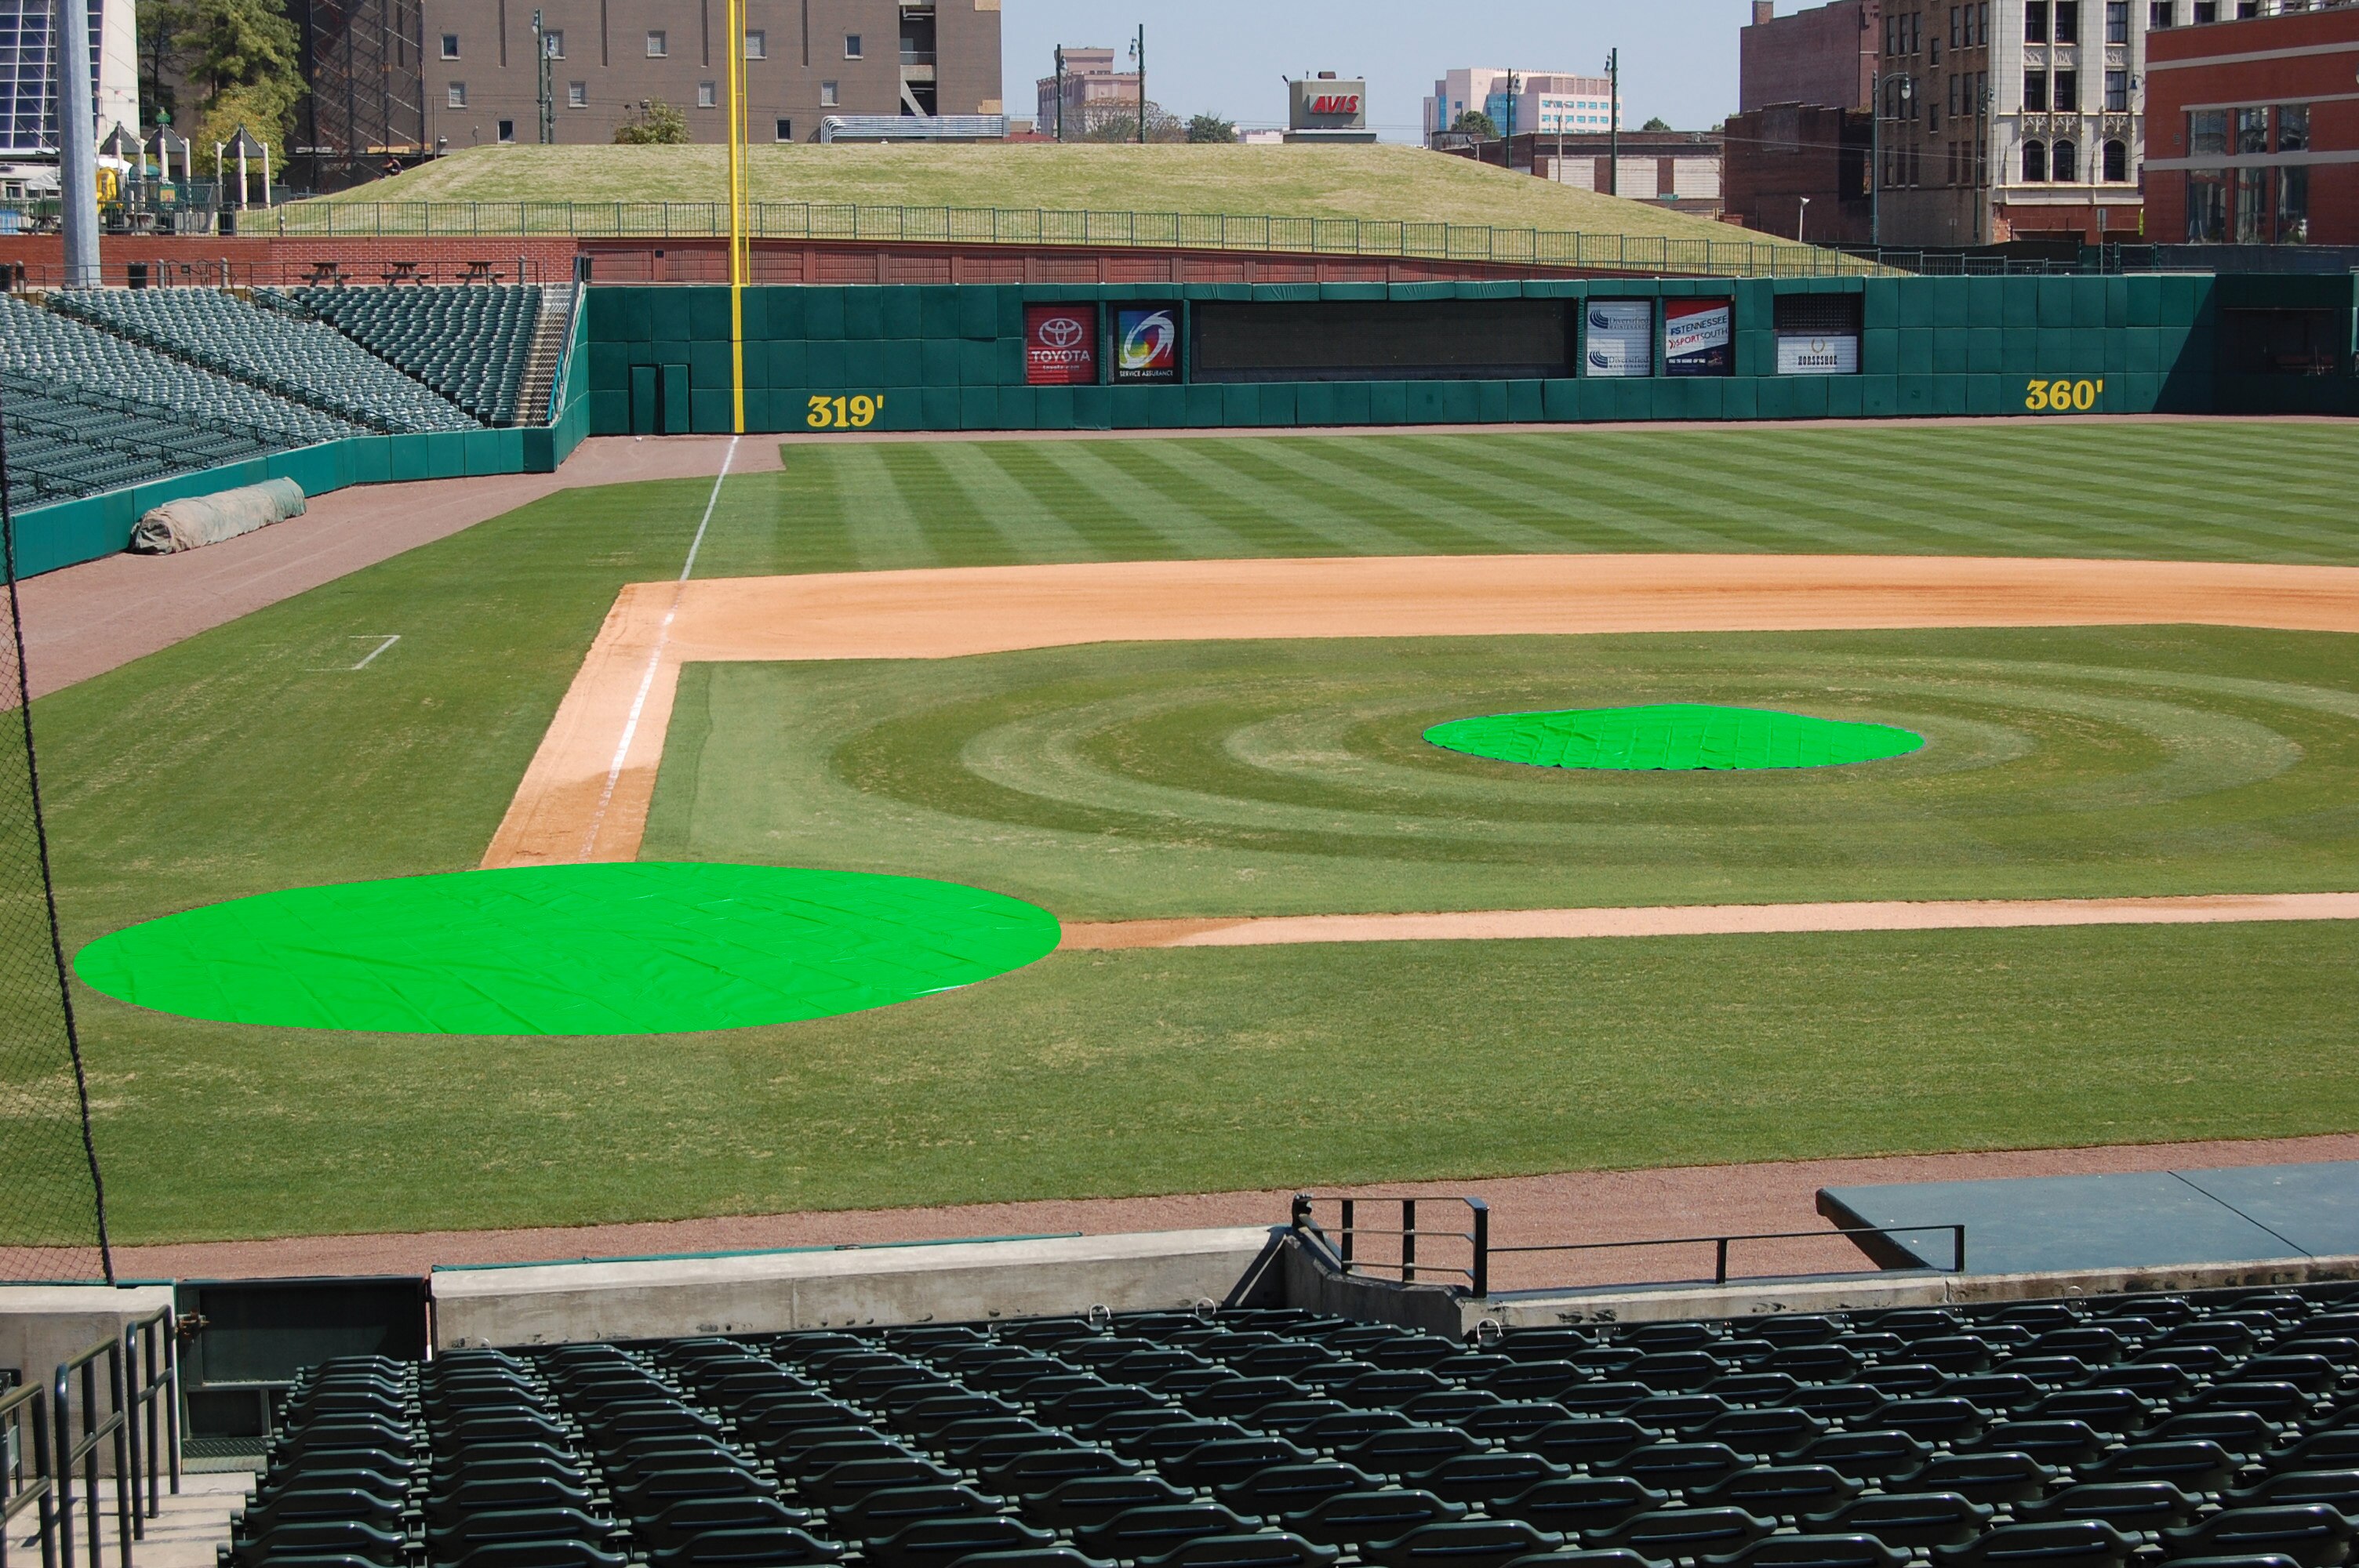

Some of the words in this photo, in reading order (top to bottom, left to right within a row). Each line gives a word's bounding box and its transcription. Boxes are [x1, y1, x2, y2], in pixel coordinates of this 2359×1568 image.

[1312, 95, 1359, 114] AVIS
[1609, 316, 1650, 325] Diversified
[1031, 350, 1091, 363] TOYOTA
[1608, 355, 1650, 364] Diversified
[1797, 354, 1838, 366] HORSESHOE
[2025, 379, 2103, 410] 360'
[807, 394, 884, 427] 319'
